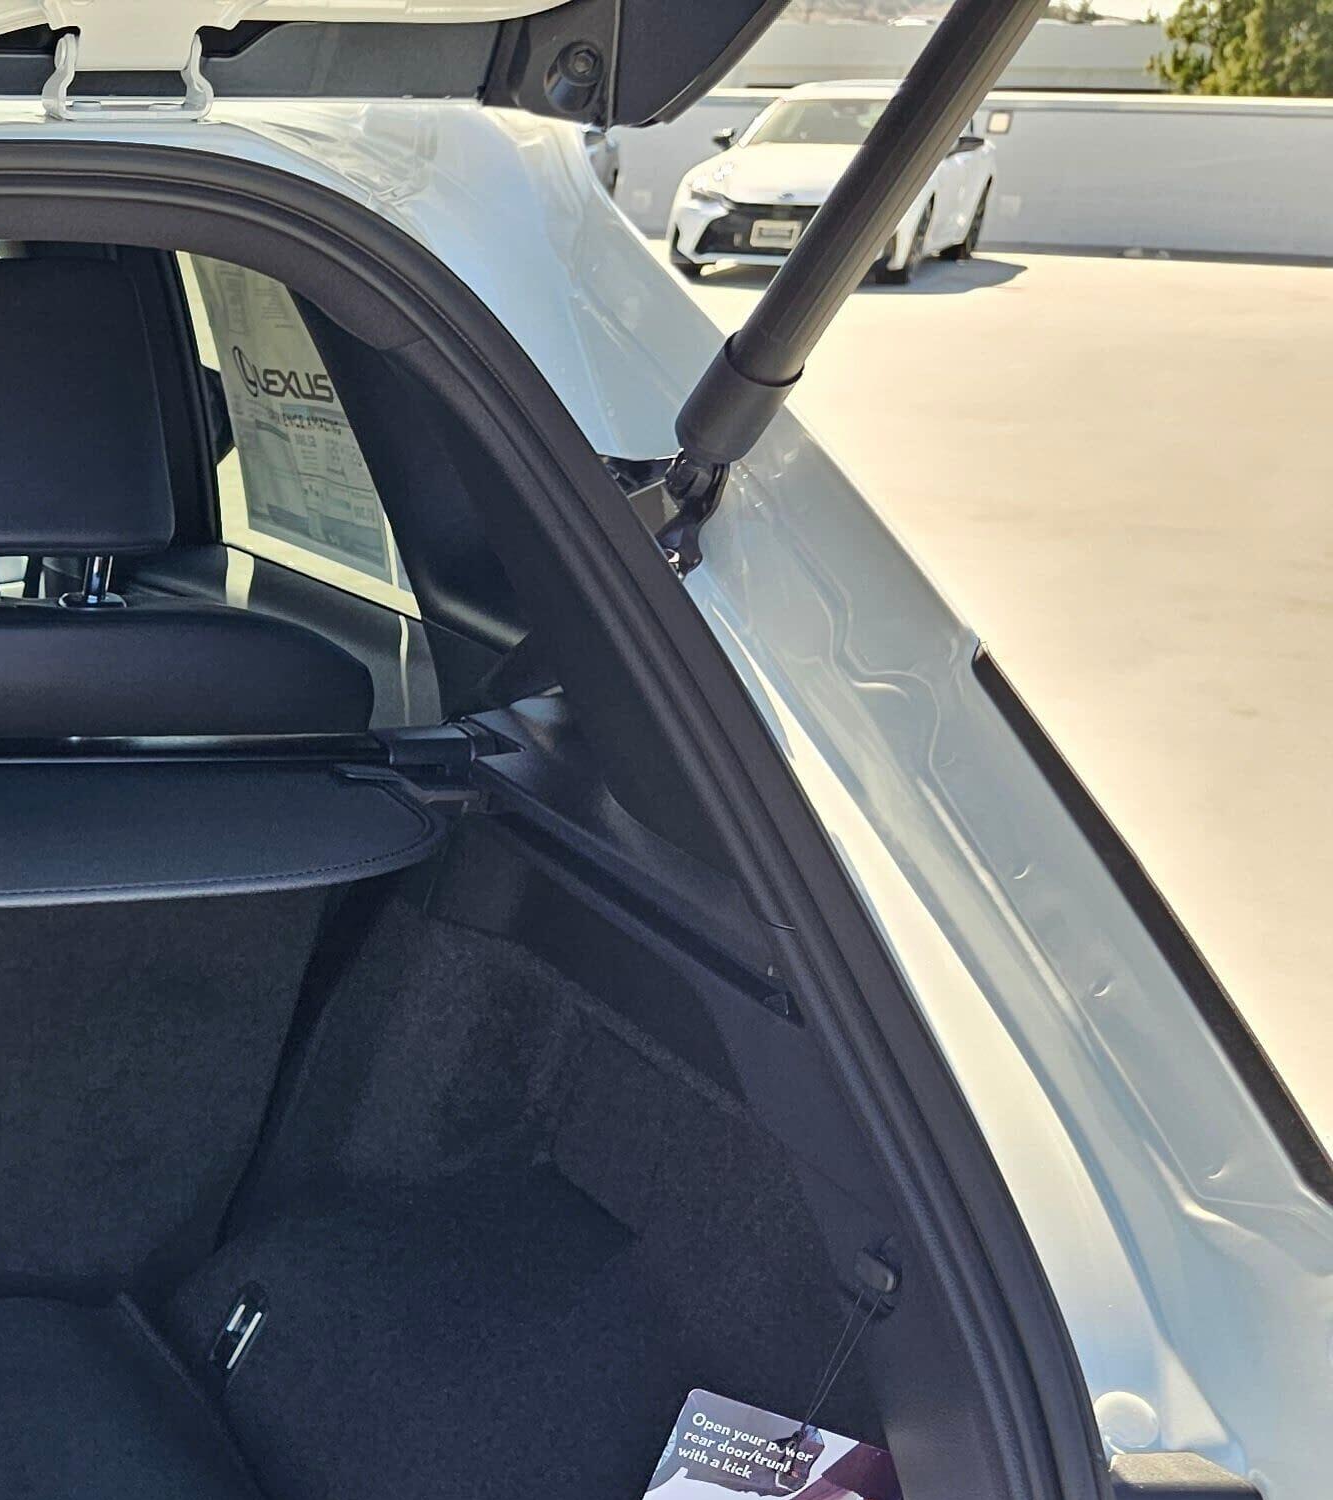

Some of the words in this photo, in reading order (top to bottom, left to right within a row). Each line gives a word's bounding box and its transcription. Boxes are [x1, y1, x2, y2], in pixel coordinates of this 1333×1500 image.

[253, 364, 334, 403] LEXUS
[683, 1431, 715, 1448] rear
[692, 1412, 731, 1436] Open
[732, 1429, 766, 1446] your
[678, 1447, 708, 1464] with
[710, 1459, 720, 1469] a
[721, 1459, 752, 1479] kick
